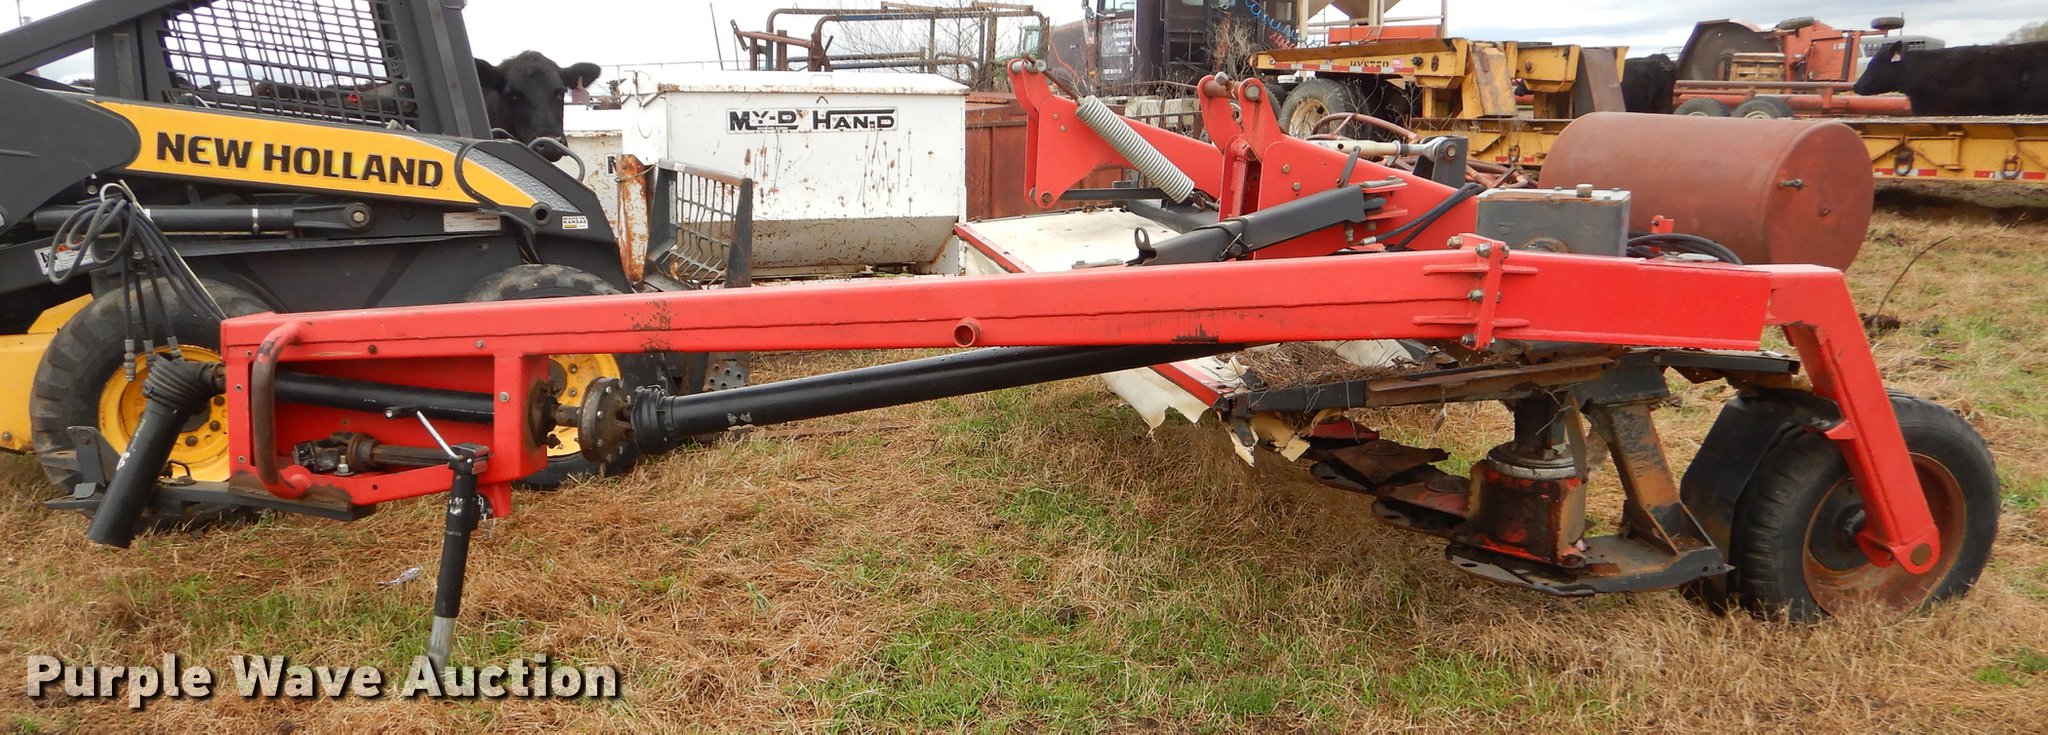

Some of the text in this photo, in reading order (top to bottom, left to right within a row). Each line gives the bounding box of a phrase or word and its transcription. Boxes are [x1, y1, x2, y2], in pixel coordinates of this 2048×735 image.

[729, 109, 896, 131] MY-D HAN-D
[157, 131, 443, 187] NEW HOLLAND
